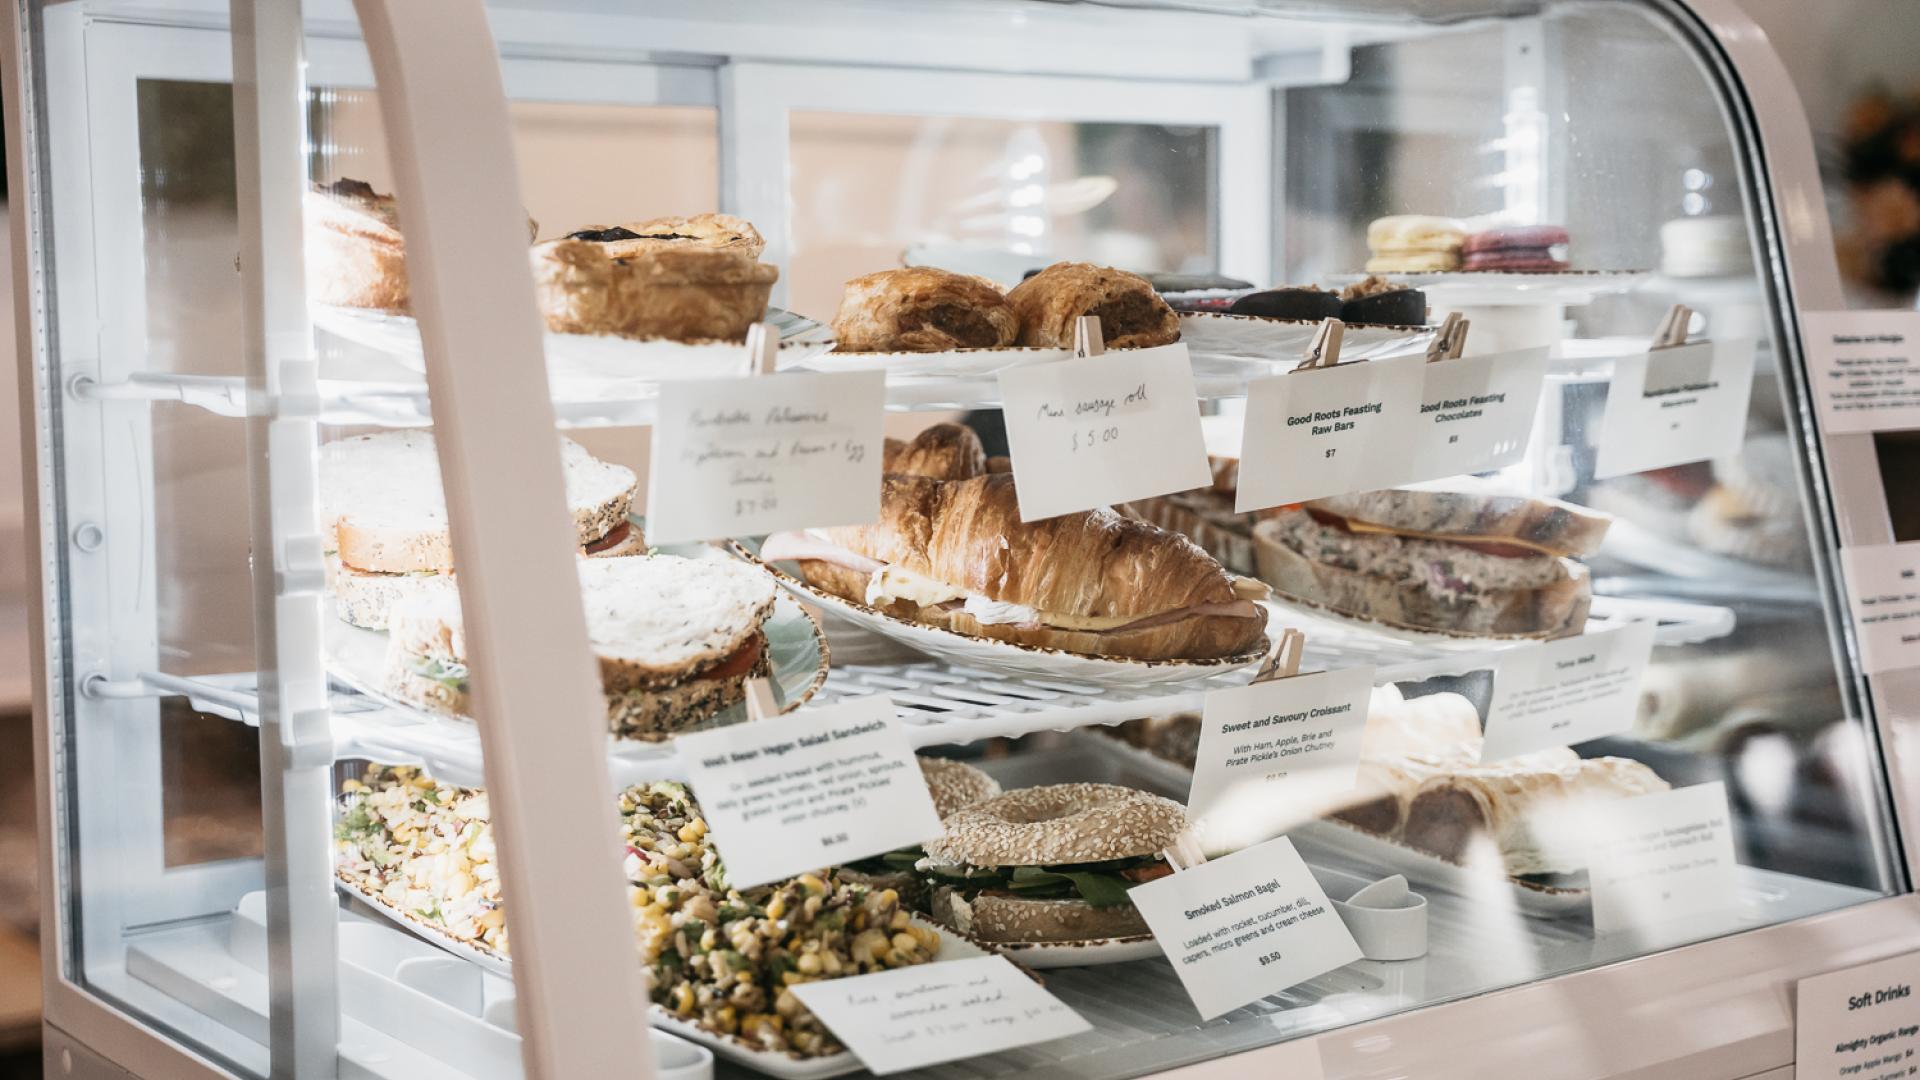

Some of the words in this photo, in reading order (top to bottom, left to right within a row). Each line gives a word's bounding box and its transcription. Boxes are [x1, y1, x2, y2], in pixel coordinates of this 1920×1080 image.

[1075, 399, 1116, 417] sausage
[1287, 412, 1312, 427] Good
[1314, 407, 1341, 422] Roots
[1343, 401, 1382, 418] Feasting
[1442, 398, 1468, 410] Roots
[1469, 392, 1506, 406] Feasting
[1311, 424, 1332, 436] Raw
[1334, 420, 1355, 431] Bars
[1434, 409, 1483, 424] Chocolates
[1325, 448, 1336, 458] $7
[1221, 722, 1251, 734] Sweet
[1252, 716, 1270, 728] and
[1272, 710, 1308, 725] Savoury
[1310, 703, 1351, 718] Croissant
[798, 732, 830, 748] Salad
[832, 719, 887, 740] Sandwich
[1233, 744, 1252, 755] With
[1254, 739, 1273, 750] Ham,
[1275, 736, 1299, 748] Apple,
[1301, 732, 1316, 742] Brie
[1318, 729, 1333, 739] and
[815, 761, 837, 773] with
[1225, 756, 1248, 768] Pirate
[1250, 751, 1279, 764] Pickle's
[1280, 747, 1303, 758] Onion
[1304, 741, 1336, 754] Chutney
[808, 792, 826, 804] and
[1185, 902, 1222, 921] Smoked
[1222, 889, 1256, 907] Salmon
[1256, 878, 1281, 895] Bagel
[1182, 949, 1212, 965] capers,
[1211, 939, 1234, 954] micro
[1234, 930, 1260, 947] greens
[1261, 924, 1275, 936] and
[1275, 915, 1299, 930] cream
[1298, 905, 1325, 921] cheese
[1183, 932, 1213, 950] Loaded
[1213, 925, 1231, 939] with
[1231, 916, 1258, 933] rocket,
[1257, 903, 1295, 922] cucumber,
[1848, 992, 1872, 1011] Soft
[1875, 984, 1911, 1004] Drinks
[1869, 1030, 1897, 1045] Organic
